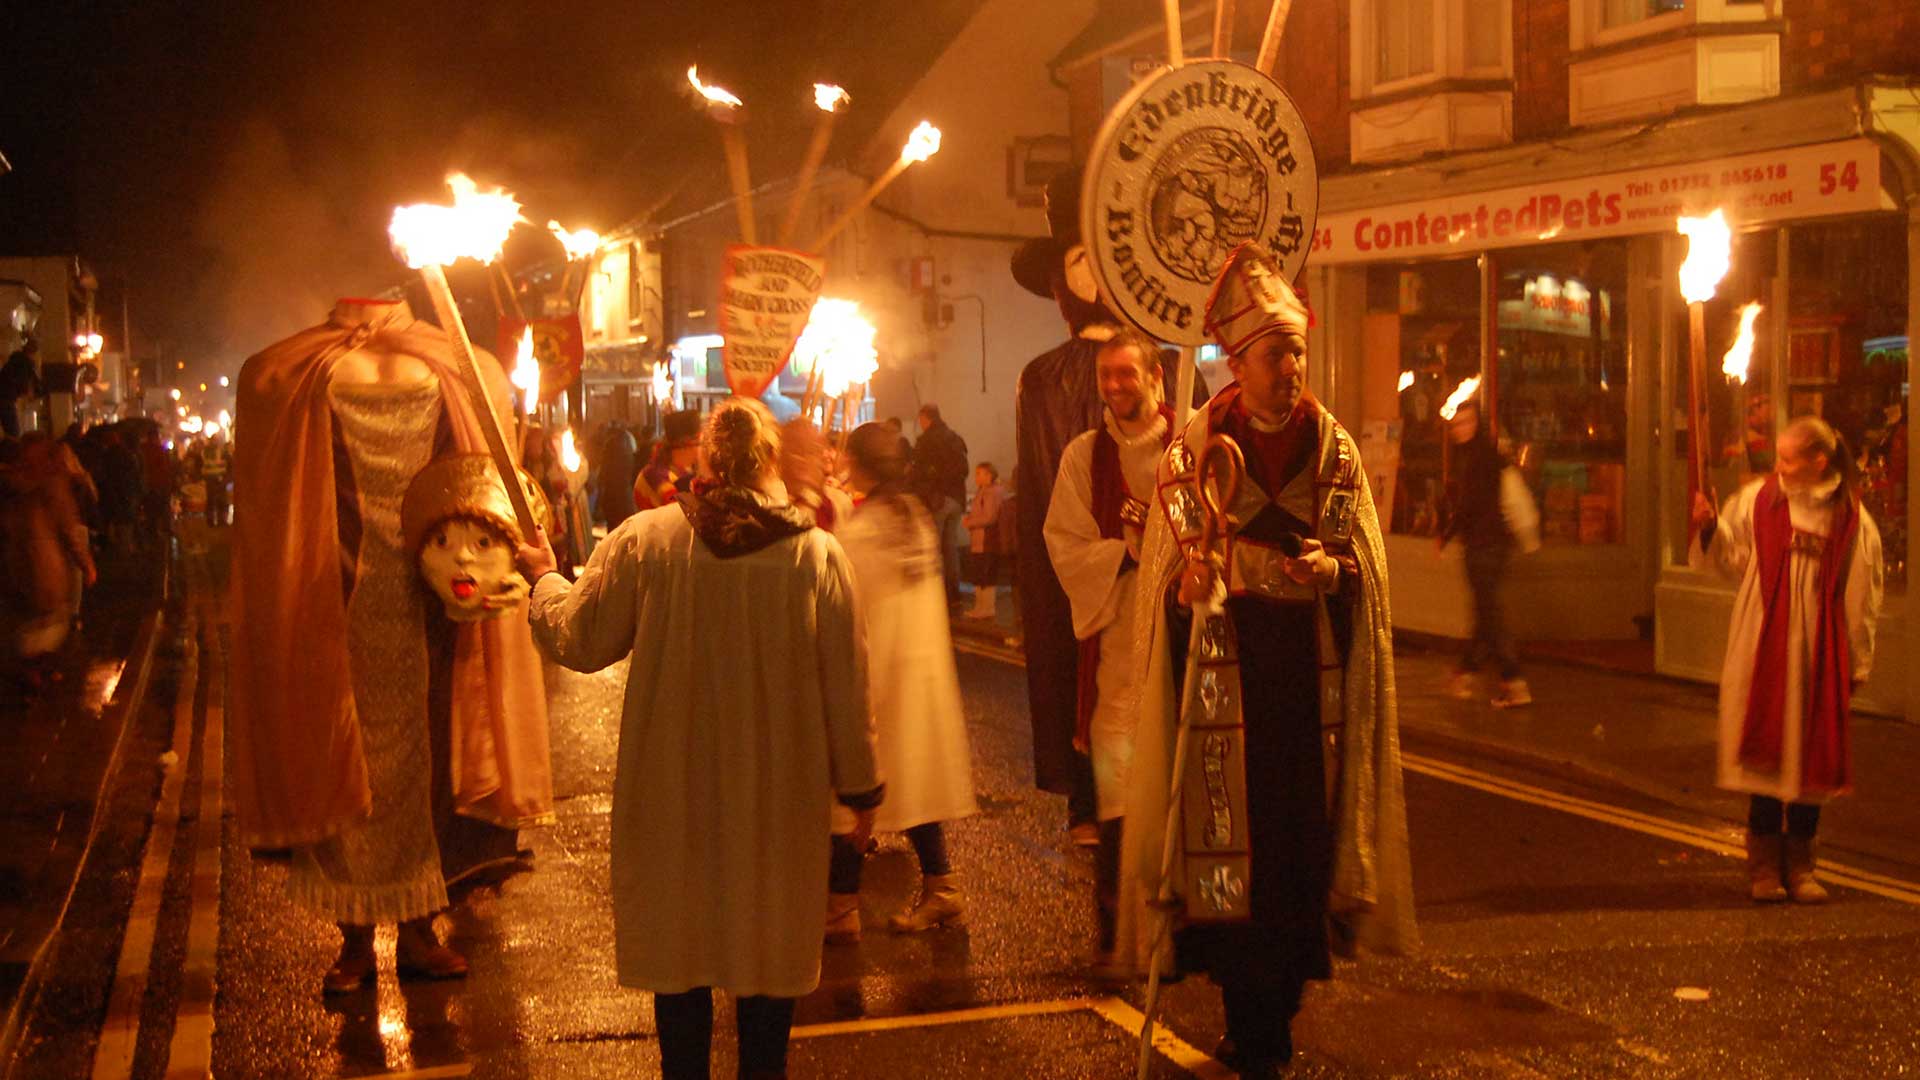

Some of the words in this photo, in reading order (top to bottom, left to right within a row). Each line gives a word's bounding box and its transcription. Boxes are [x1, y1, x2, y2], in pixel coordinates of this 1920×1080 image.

[1118, 72, 1297, 176] Edenbridge
[1626, 182, 1653, 198] Tel:
[1819, 160, 1859, 195] 54
[1312, 228, 1333, 251] 54
[1354, 190, 1622, 252] ContentedPets
[1107, 207, 1193, 330] Bonfire
